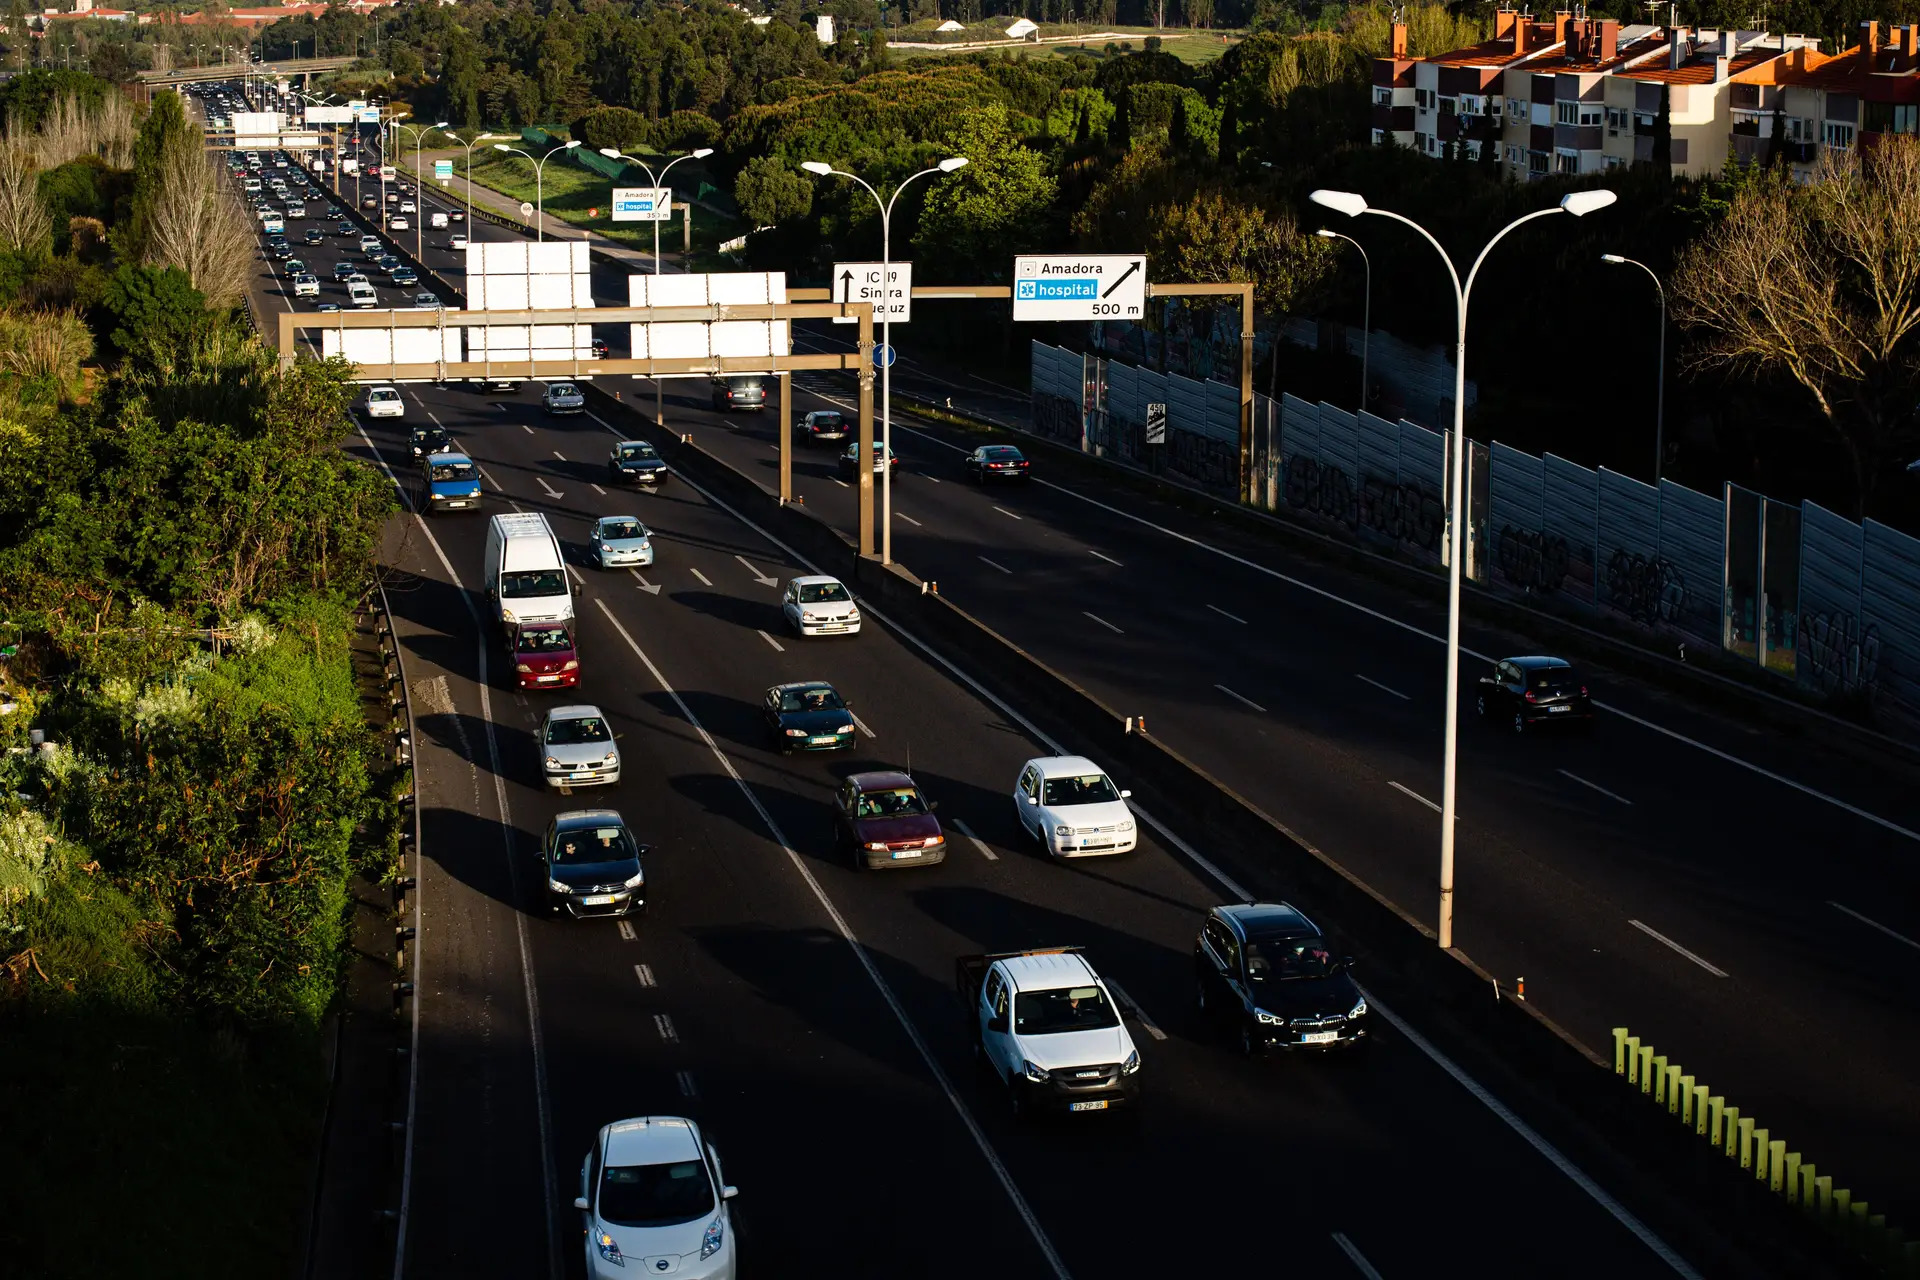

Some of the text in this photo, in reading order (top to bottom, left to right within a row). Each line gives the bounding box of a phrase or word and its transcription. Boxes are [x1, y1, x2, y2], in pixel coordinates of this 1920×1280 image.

[1041, 263, 1104, 275] Amadora
[866, 271, 897, 283] IC 19
[860, 287, 902, 298] Sinra
[1039, 283, 1096, 298] hospital
[1092, 303, 1139, 315] 500 m
